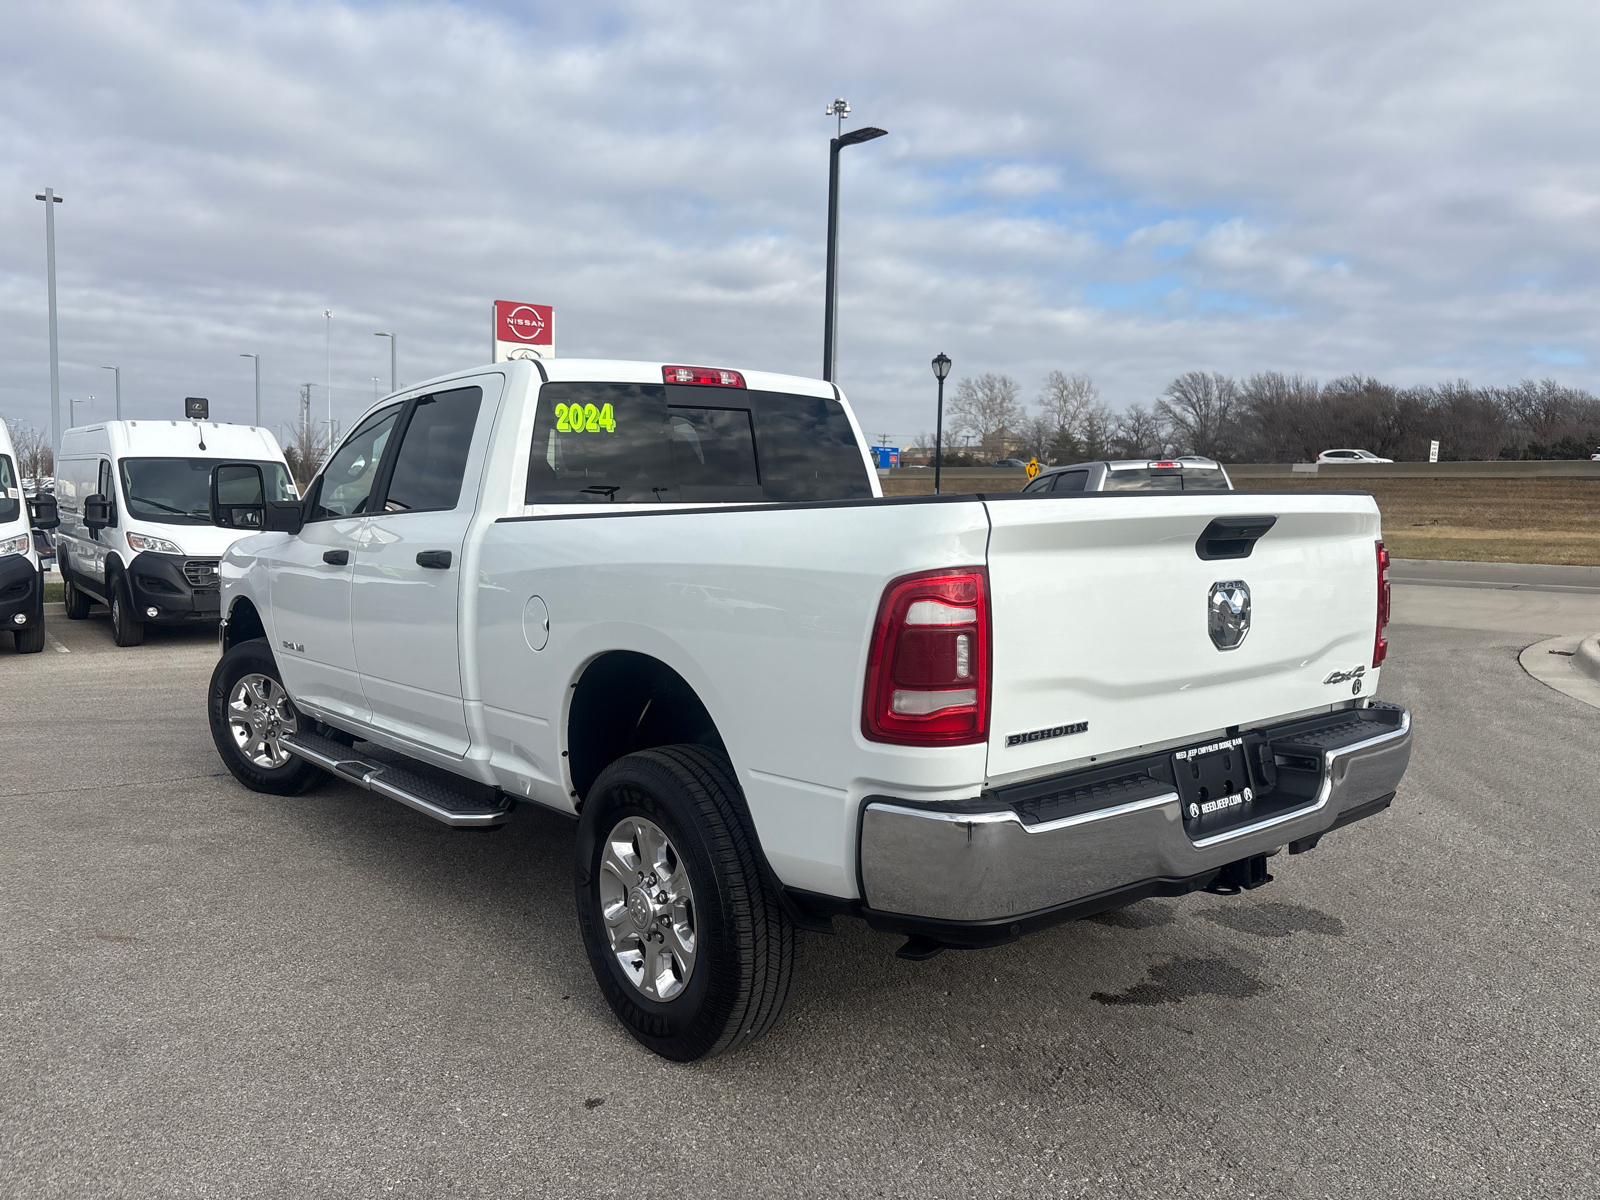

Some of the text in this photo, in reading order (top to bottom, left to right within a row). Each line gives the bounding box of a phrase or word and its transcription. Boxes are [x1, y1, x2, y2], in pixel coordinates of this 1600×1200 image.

[507, 317, 545, 328] NISSAN
[555, 403, 616, 433] 2024
[1005, 720, 1089, 748] BIGHORN
[1176, 738, 1242, 760] REED JEEP CHRYSLER DODGE RAM
[1202, 794, 1242, 814] REEDJEEP.COM
